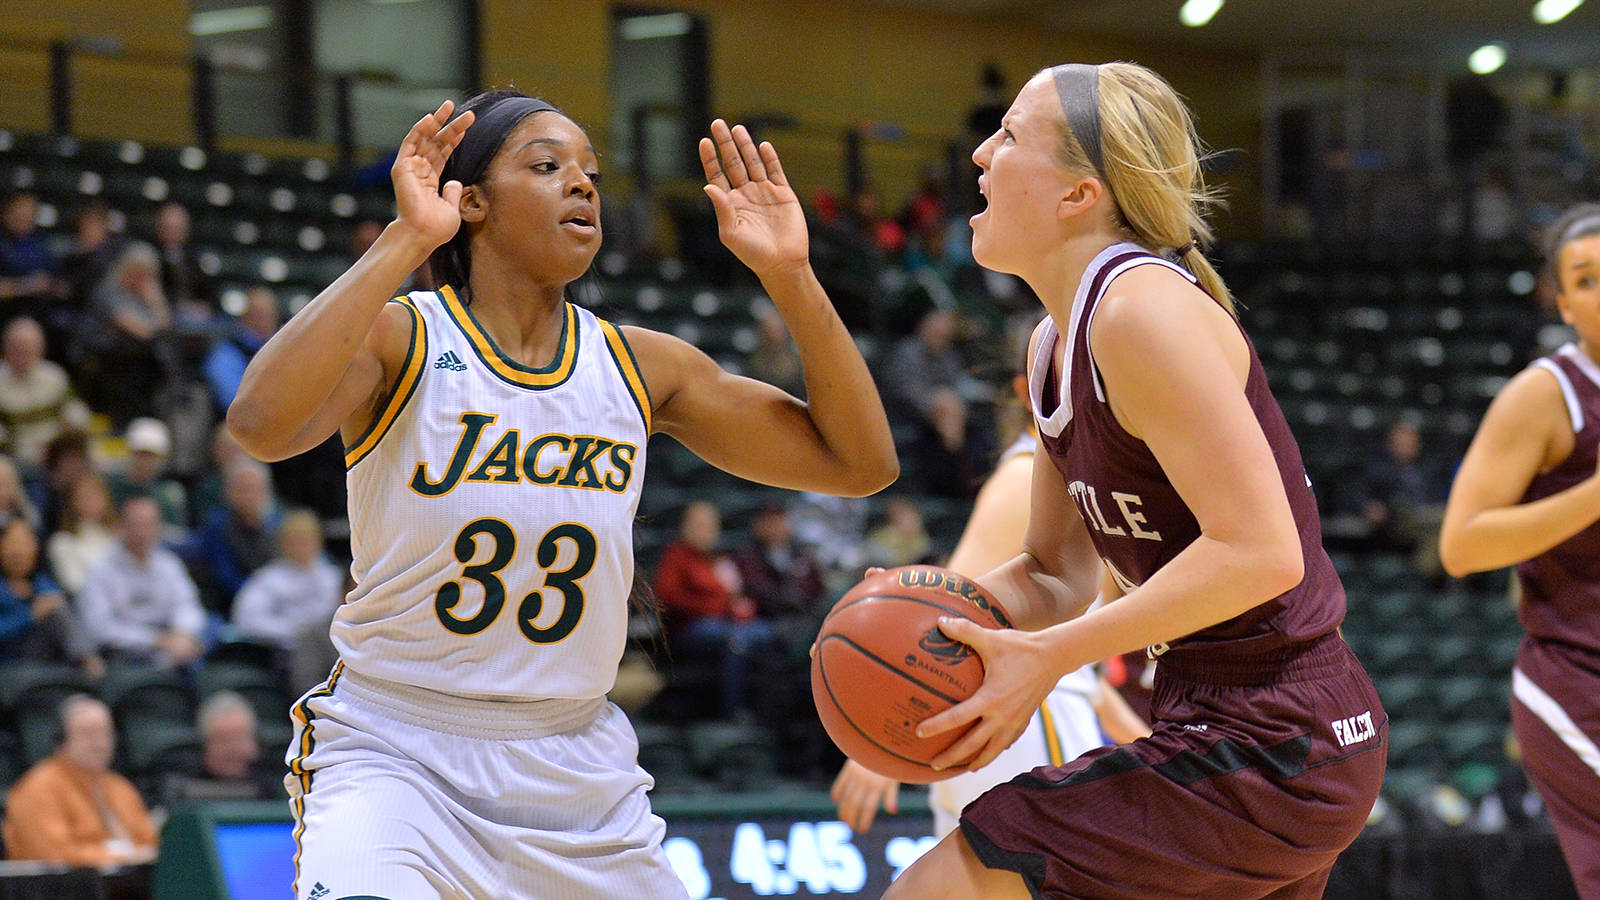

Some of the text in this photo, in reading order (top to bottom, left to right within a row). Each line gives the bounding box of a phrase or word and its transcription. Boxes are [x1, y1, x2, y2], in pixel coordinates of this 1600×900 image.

[433, 360, 468, 372] adidas
[408, 411, 639, 499] JACKS
[433, 516, 599, 646] 33
[730, 821, 867, 895] 4:45
